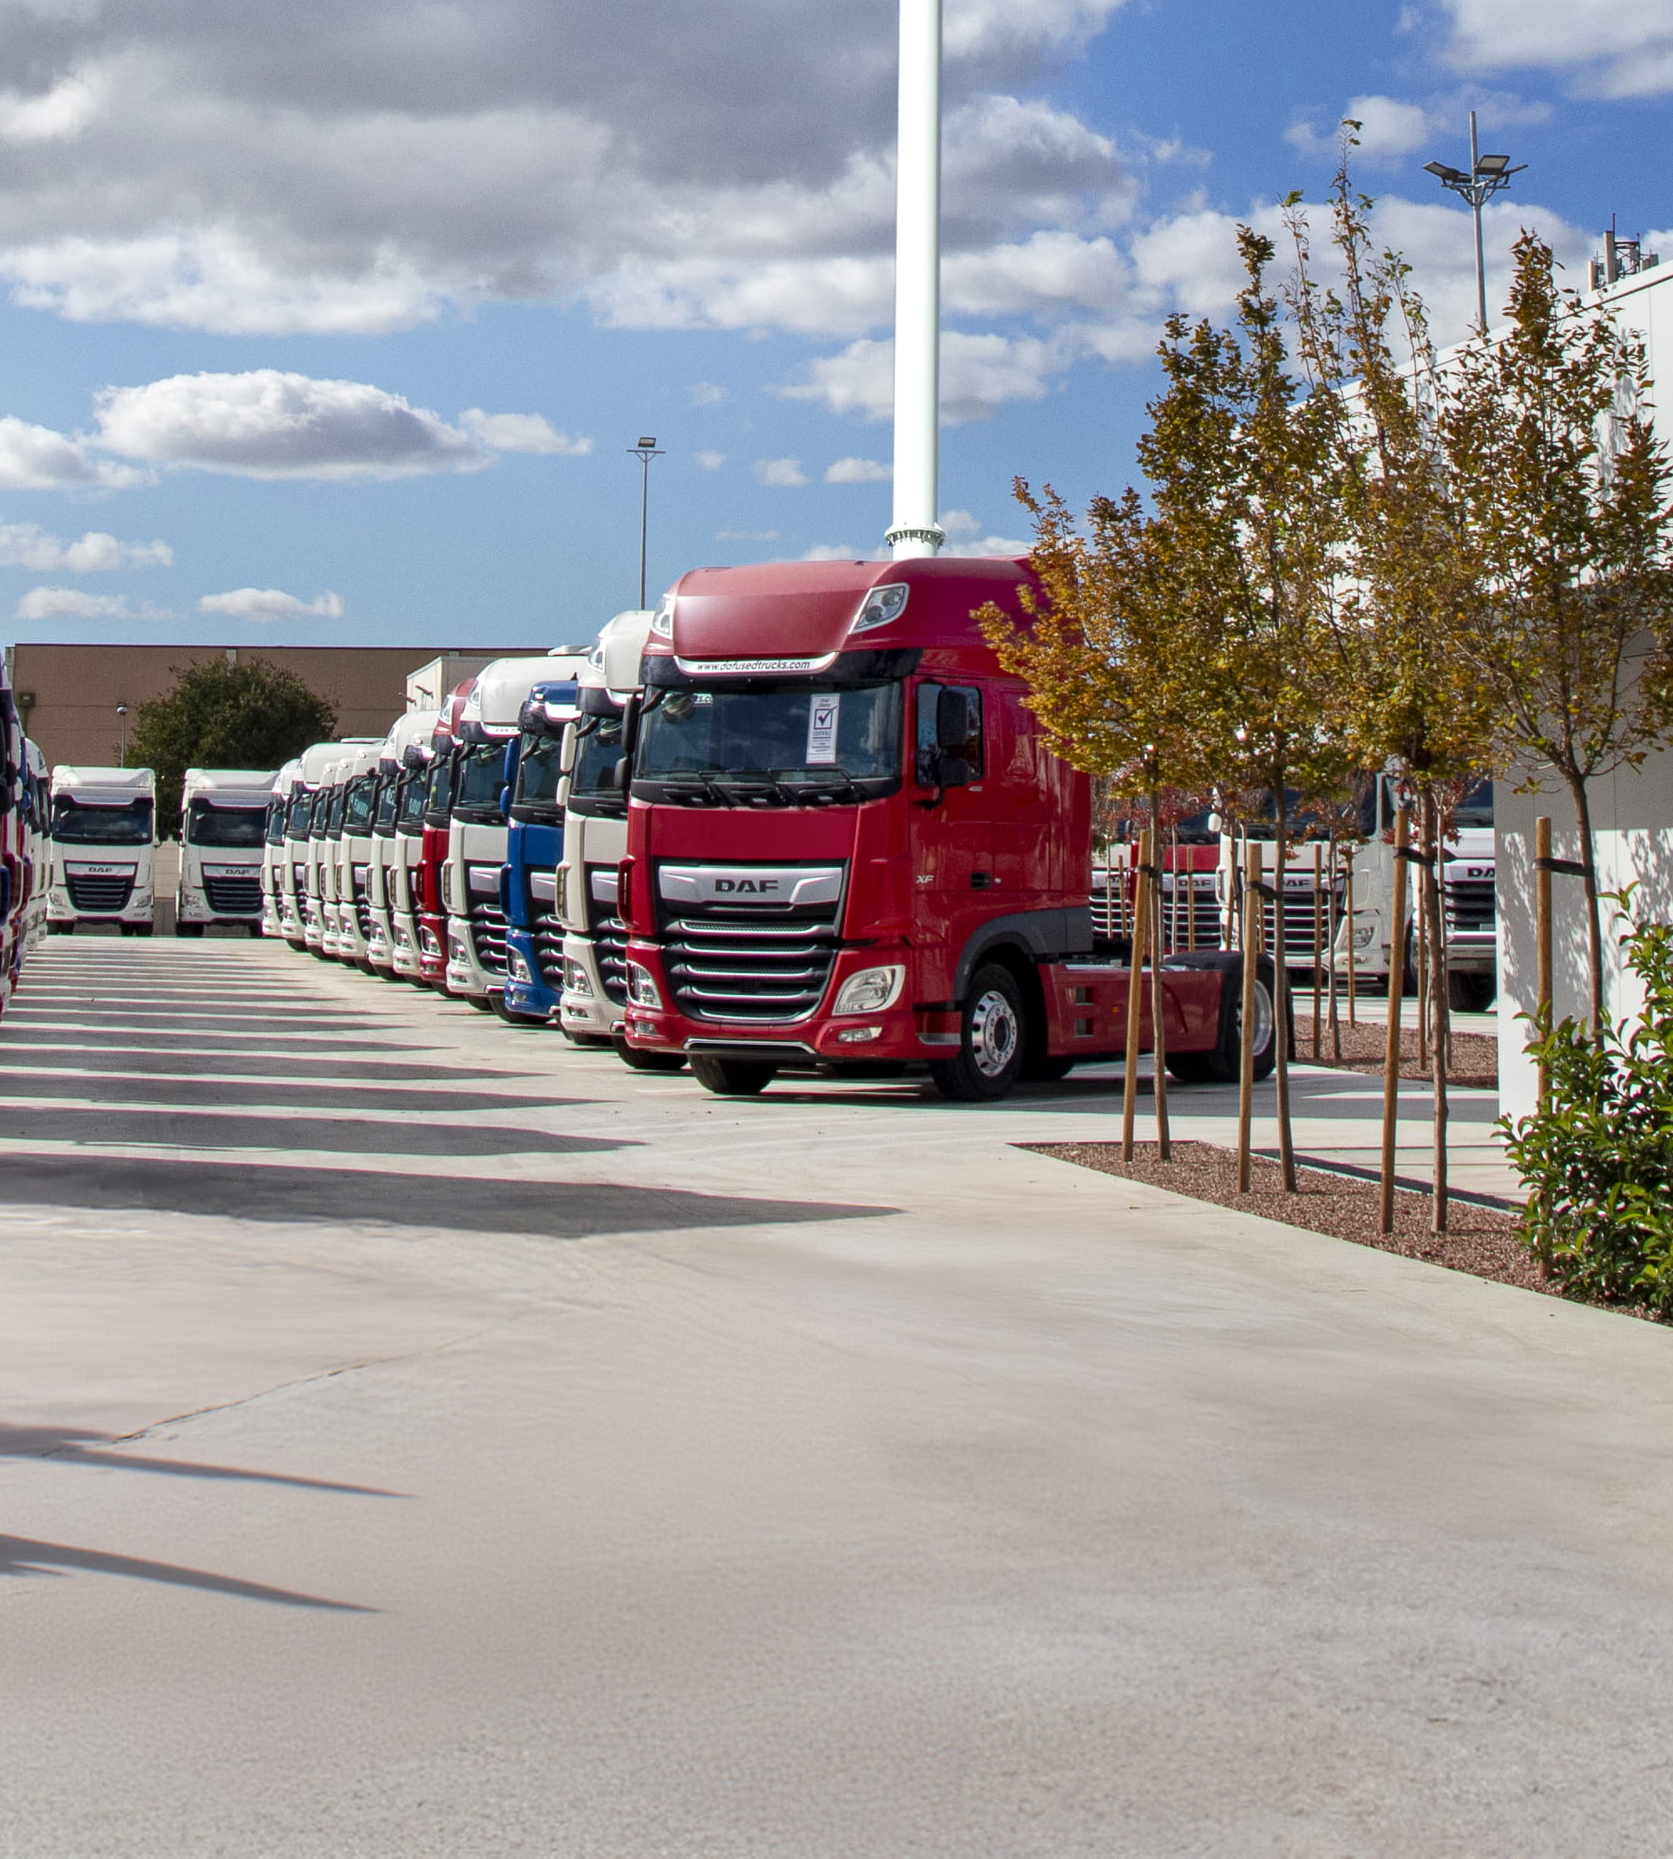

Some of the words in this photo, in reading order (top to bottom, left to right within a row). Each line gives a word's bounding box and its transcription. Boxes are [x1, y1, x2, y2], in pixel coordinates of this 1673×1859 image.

[696, 659, 811, 671] www.dafusedtrucks.com
[1468, 867, 1495, 878] DA
[916, 875, 934, 883] XF
[714, 878, 778, 893] DAF
